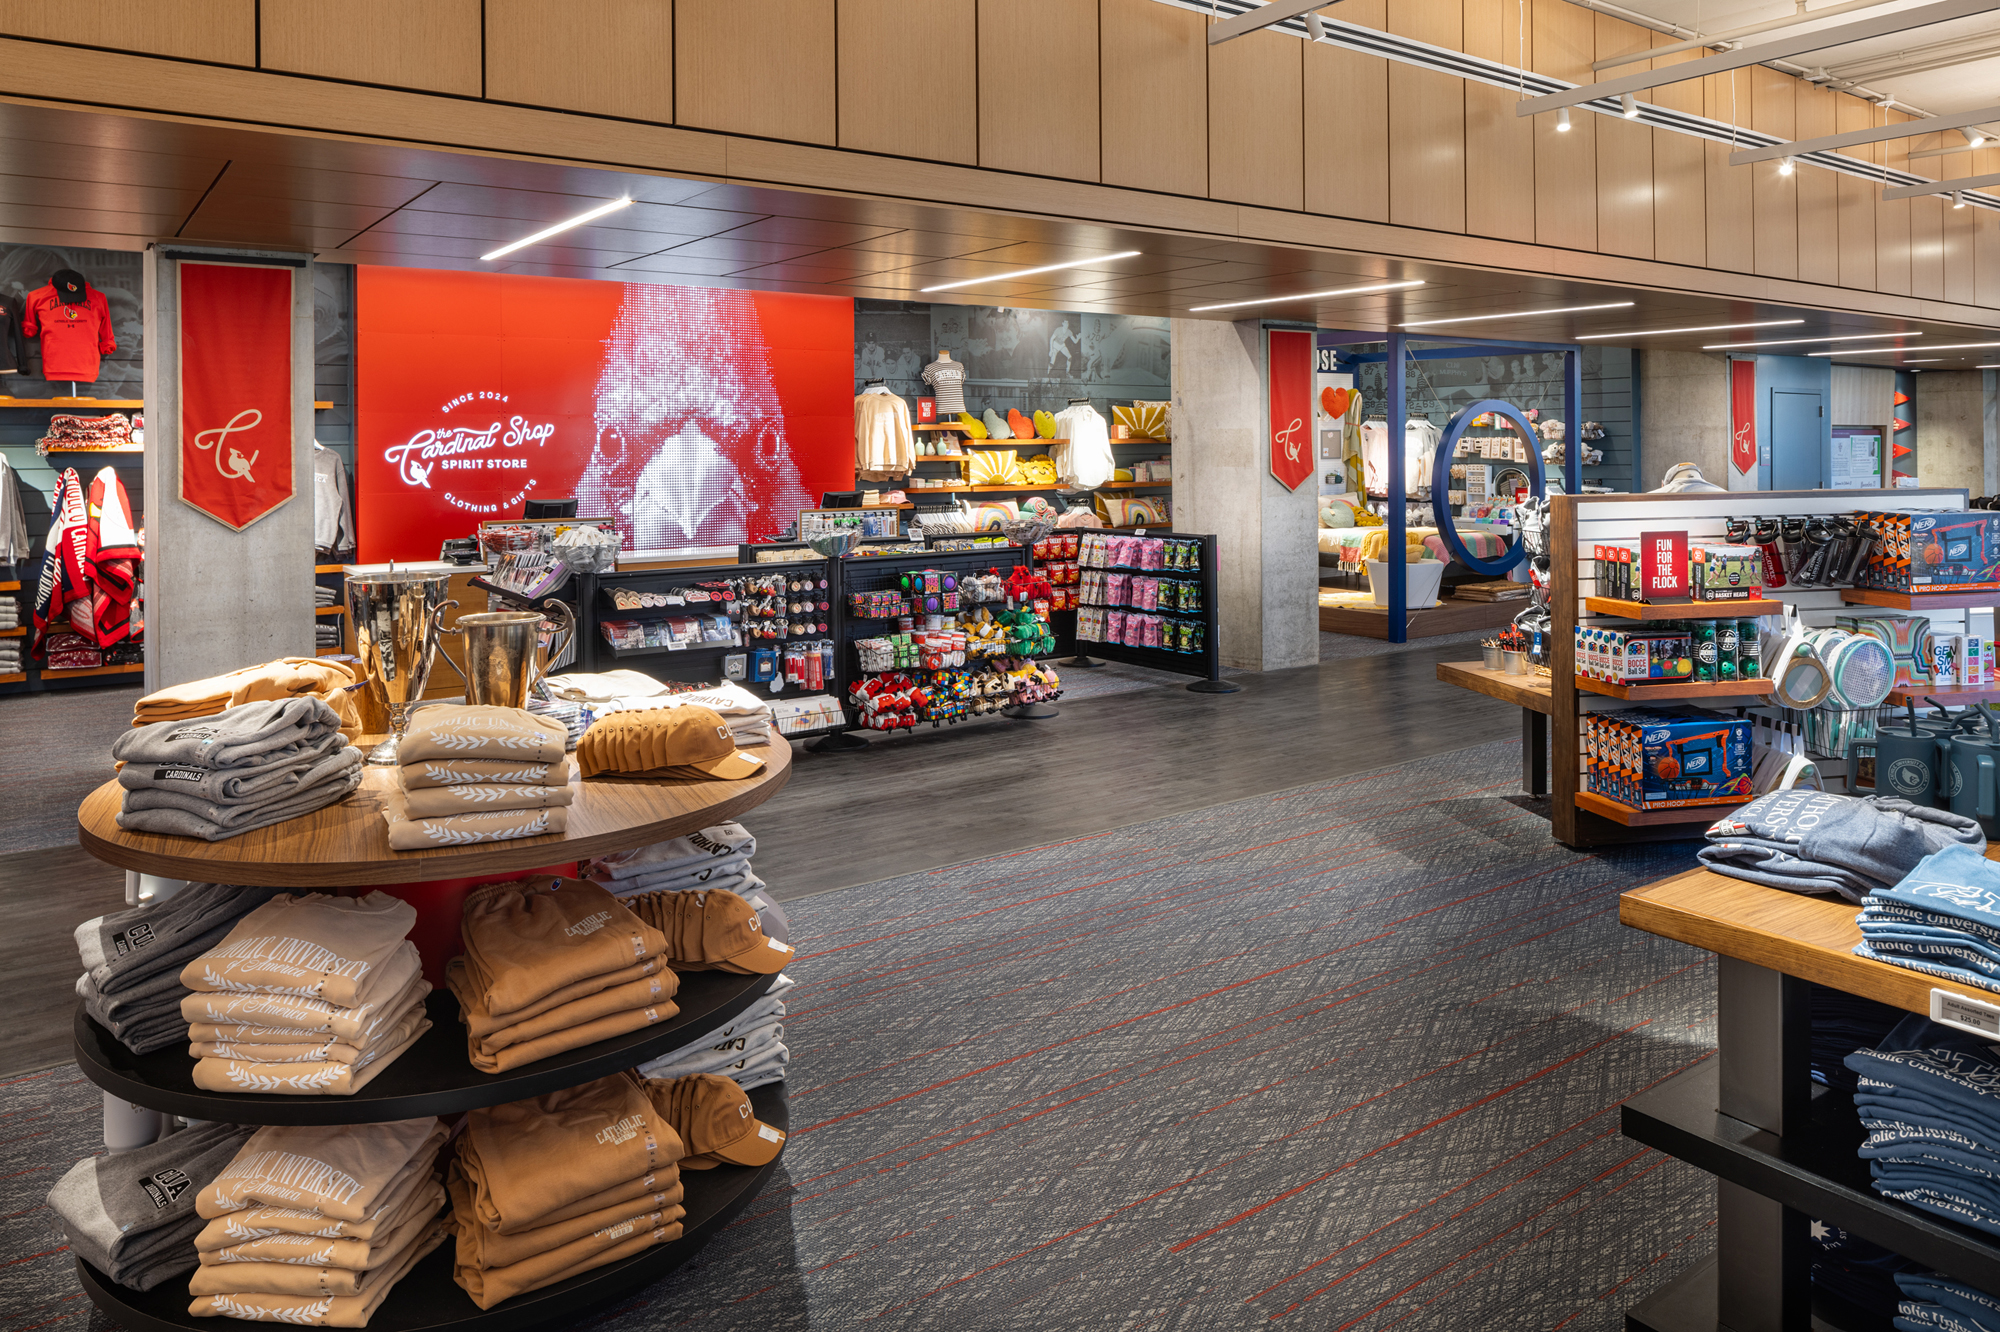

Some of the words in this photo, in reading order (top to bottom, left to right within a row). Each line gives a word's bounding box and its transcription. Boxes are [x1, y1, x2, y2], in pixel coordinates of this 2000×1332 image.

[442, 392, 474, 413] SINCE
[479, 391, 509, 403] 2024
[436, 428, 453, 440] the
[384, 422, 502, 488] Cardinal
[502, 415, 555, 447] Shop
[441, 459, 484, 470] SPIRIT
[486, 459, 528, 469] STORE
[443, 492, 498, 513] CLOTHING
[502, 502, 510, 510] &
[1913, 518, 1937, 532] NERF
[1656, 539, 1672, 551] FUN
[1884, 520, 1897, 558] NERF
[1897, 522, 1911, 560] NERF
[1657, 551, 1672, 564] FOR
[1949, 543, 1967, 557] NERF
[1657, 564, 1672, 576] THE
[1652, 576, 1678, 589] FLOCK
[1934, 645, 1957, 656] GEN
[1627, 659, 1647, 668] BOCCE
[1627, 667, 1637, 675] Ball
[1637, 667, 1647, 675] Set
[1587, 719, 1598, 759] NERF
[1598, 722, 1609, 763] NERF
[1608, 725, 1620, 767] NERF
[1644, 729, 1671, 745] NERF
[1620, 728, 1632, 770] NERF
[1631, 732, 1643, 775] NERF
[1686, 756, 1707, 770] NERF
[1896, 759, 1920, 767] UNIVERSITY
[165, 770, 203, 782] CARDINALS
[1666, 800, 1686, 808] HOOP
[563, 910, 613, 938] CATHOLIC
[240, 957, 308, 978] America
[267, 936, 372, 983] UNIVERSITY
[1918, 944, 1999, 974] University
[242, 999, 309, 1021] America
[1947, 1002, 1960, 1010] Adult
[1960, 1005, 1983, 1016] Assorted
[1983, 1011, 1995, 1020] Tees
[1960, 1014, 1981, 1026] $25.00
[1908, 1059, 1987, 1096] University
[595, 1114, 646, 1145] CATHOLIC
[153, 1168, 192, 1203] CUA
[266, 1151, 365, 1206] UNIVERSITY
[242, 1179, 302, 1202] America
